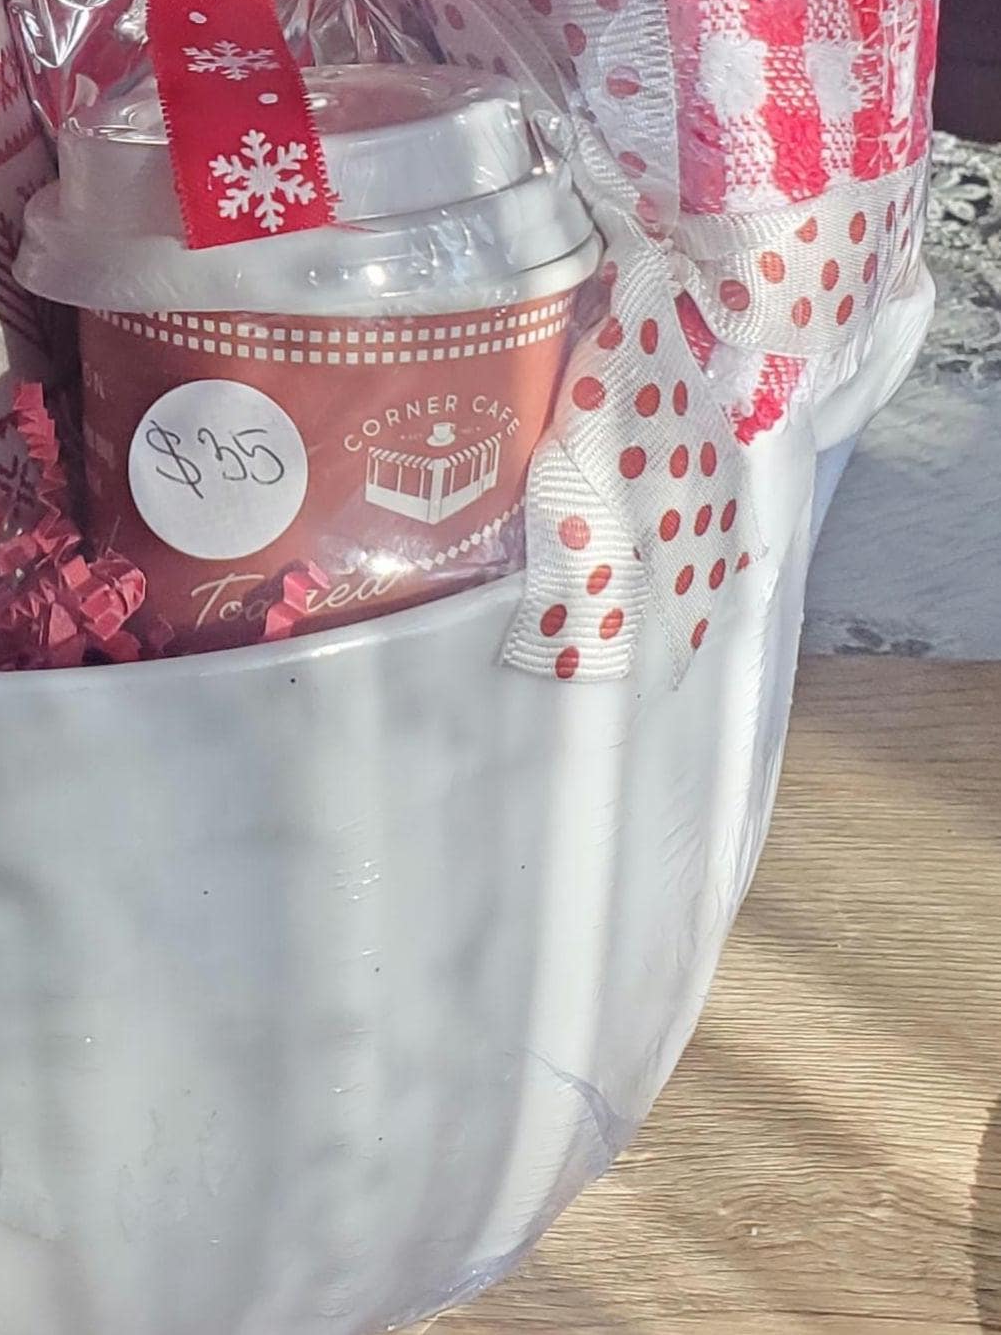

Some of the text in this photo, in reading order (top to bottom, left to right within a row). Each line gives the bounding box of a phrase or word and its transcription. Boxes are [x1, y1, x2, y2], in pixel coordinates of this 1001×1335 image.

[343, 394, 521, 452] CORNER CAFE
[145, 419, 285, 500] $35
